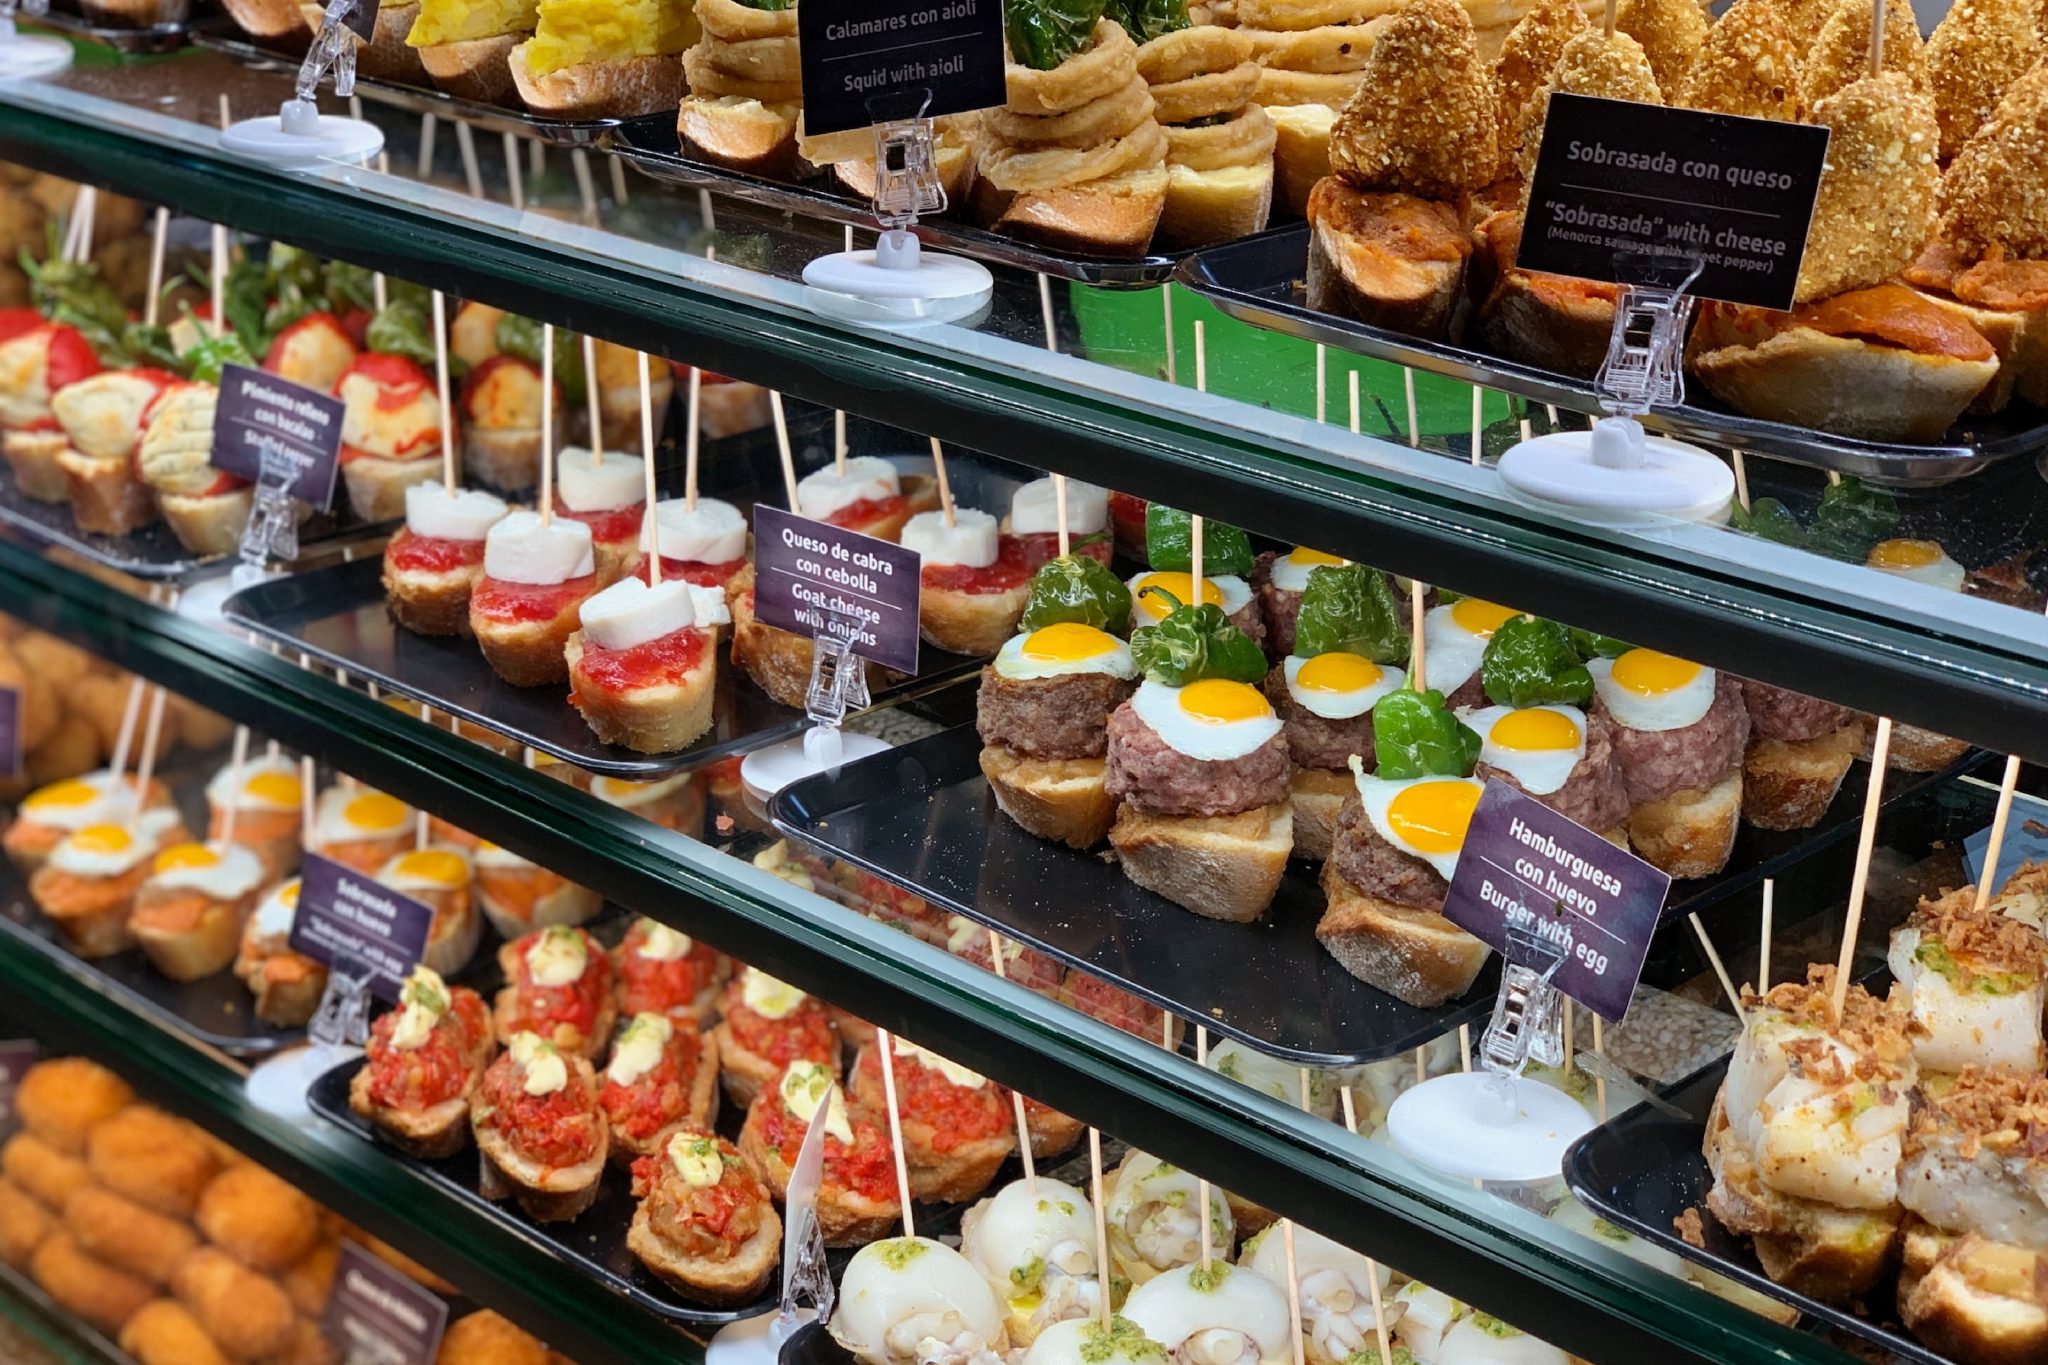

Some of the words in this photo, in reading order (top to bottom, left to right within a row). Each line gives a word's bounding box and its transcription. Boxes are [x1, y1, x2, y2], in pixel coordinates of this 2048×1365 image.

[826, 14, 907, 40] Calamares
[911, 8, 938, 26] con
[942, 0, 976, 20] aioli
[844, 68, 887, 92] Squid
[890, 62, 925, 83] with
[929, 54, 964, 77] aioli
[1567, 140, 1676, 175] Sobrasada
[1682, 159, 1719, 180] con
[1726, 165, 1792, 190] queso
[1545, 200, 1664, 236] “Sobrasada”
[1666, 221, 1711, 244] with
[1715, 229, 1787, 256] cheese
[1547, 225, 1602, 246] (Menorca
[1724, 255, 1774, 274] pepper)
[254, 408, 276, 426] con
[782, 528, 828, 555] Queso
[831, 543, 849, 562] de
[853, 552, 893, 576] cabra
[796, 558, 821, 576] con
[824, 566, 877, 594] cebolla
[792, 583, 826, 609] Goat
[830, 595, 880, 625] cheese
[794, 608, 824, 629] with
[827, 620, 877, 647] onions
[1509, 817, 1622, 897] Hamburguesa
[1515, 857, 1544, 886] con
[1546, 870, 1597, 917] huevo
[1480, 879, 1536, 926] Burger
[1536, 916, 1573, 950] with
[1576, 942, 1608, 976] egg
